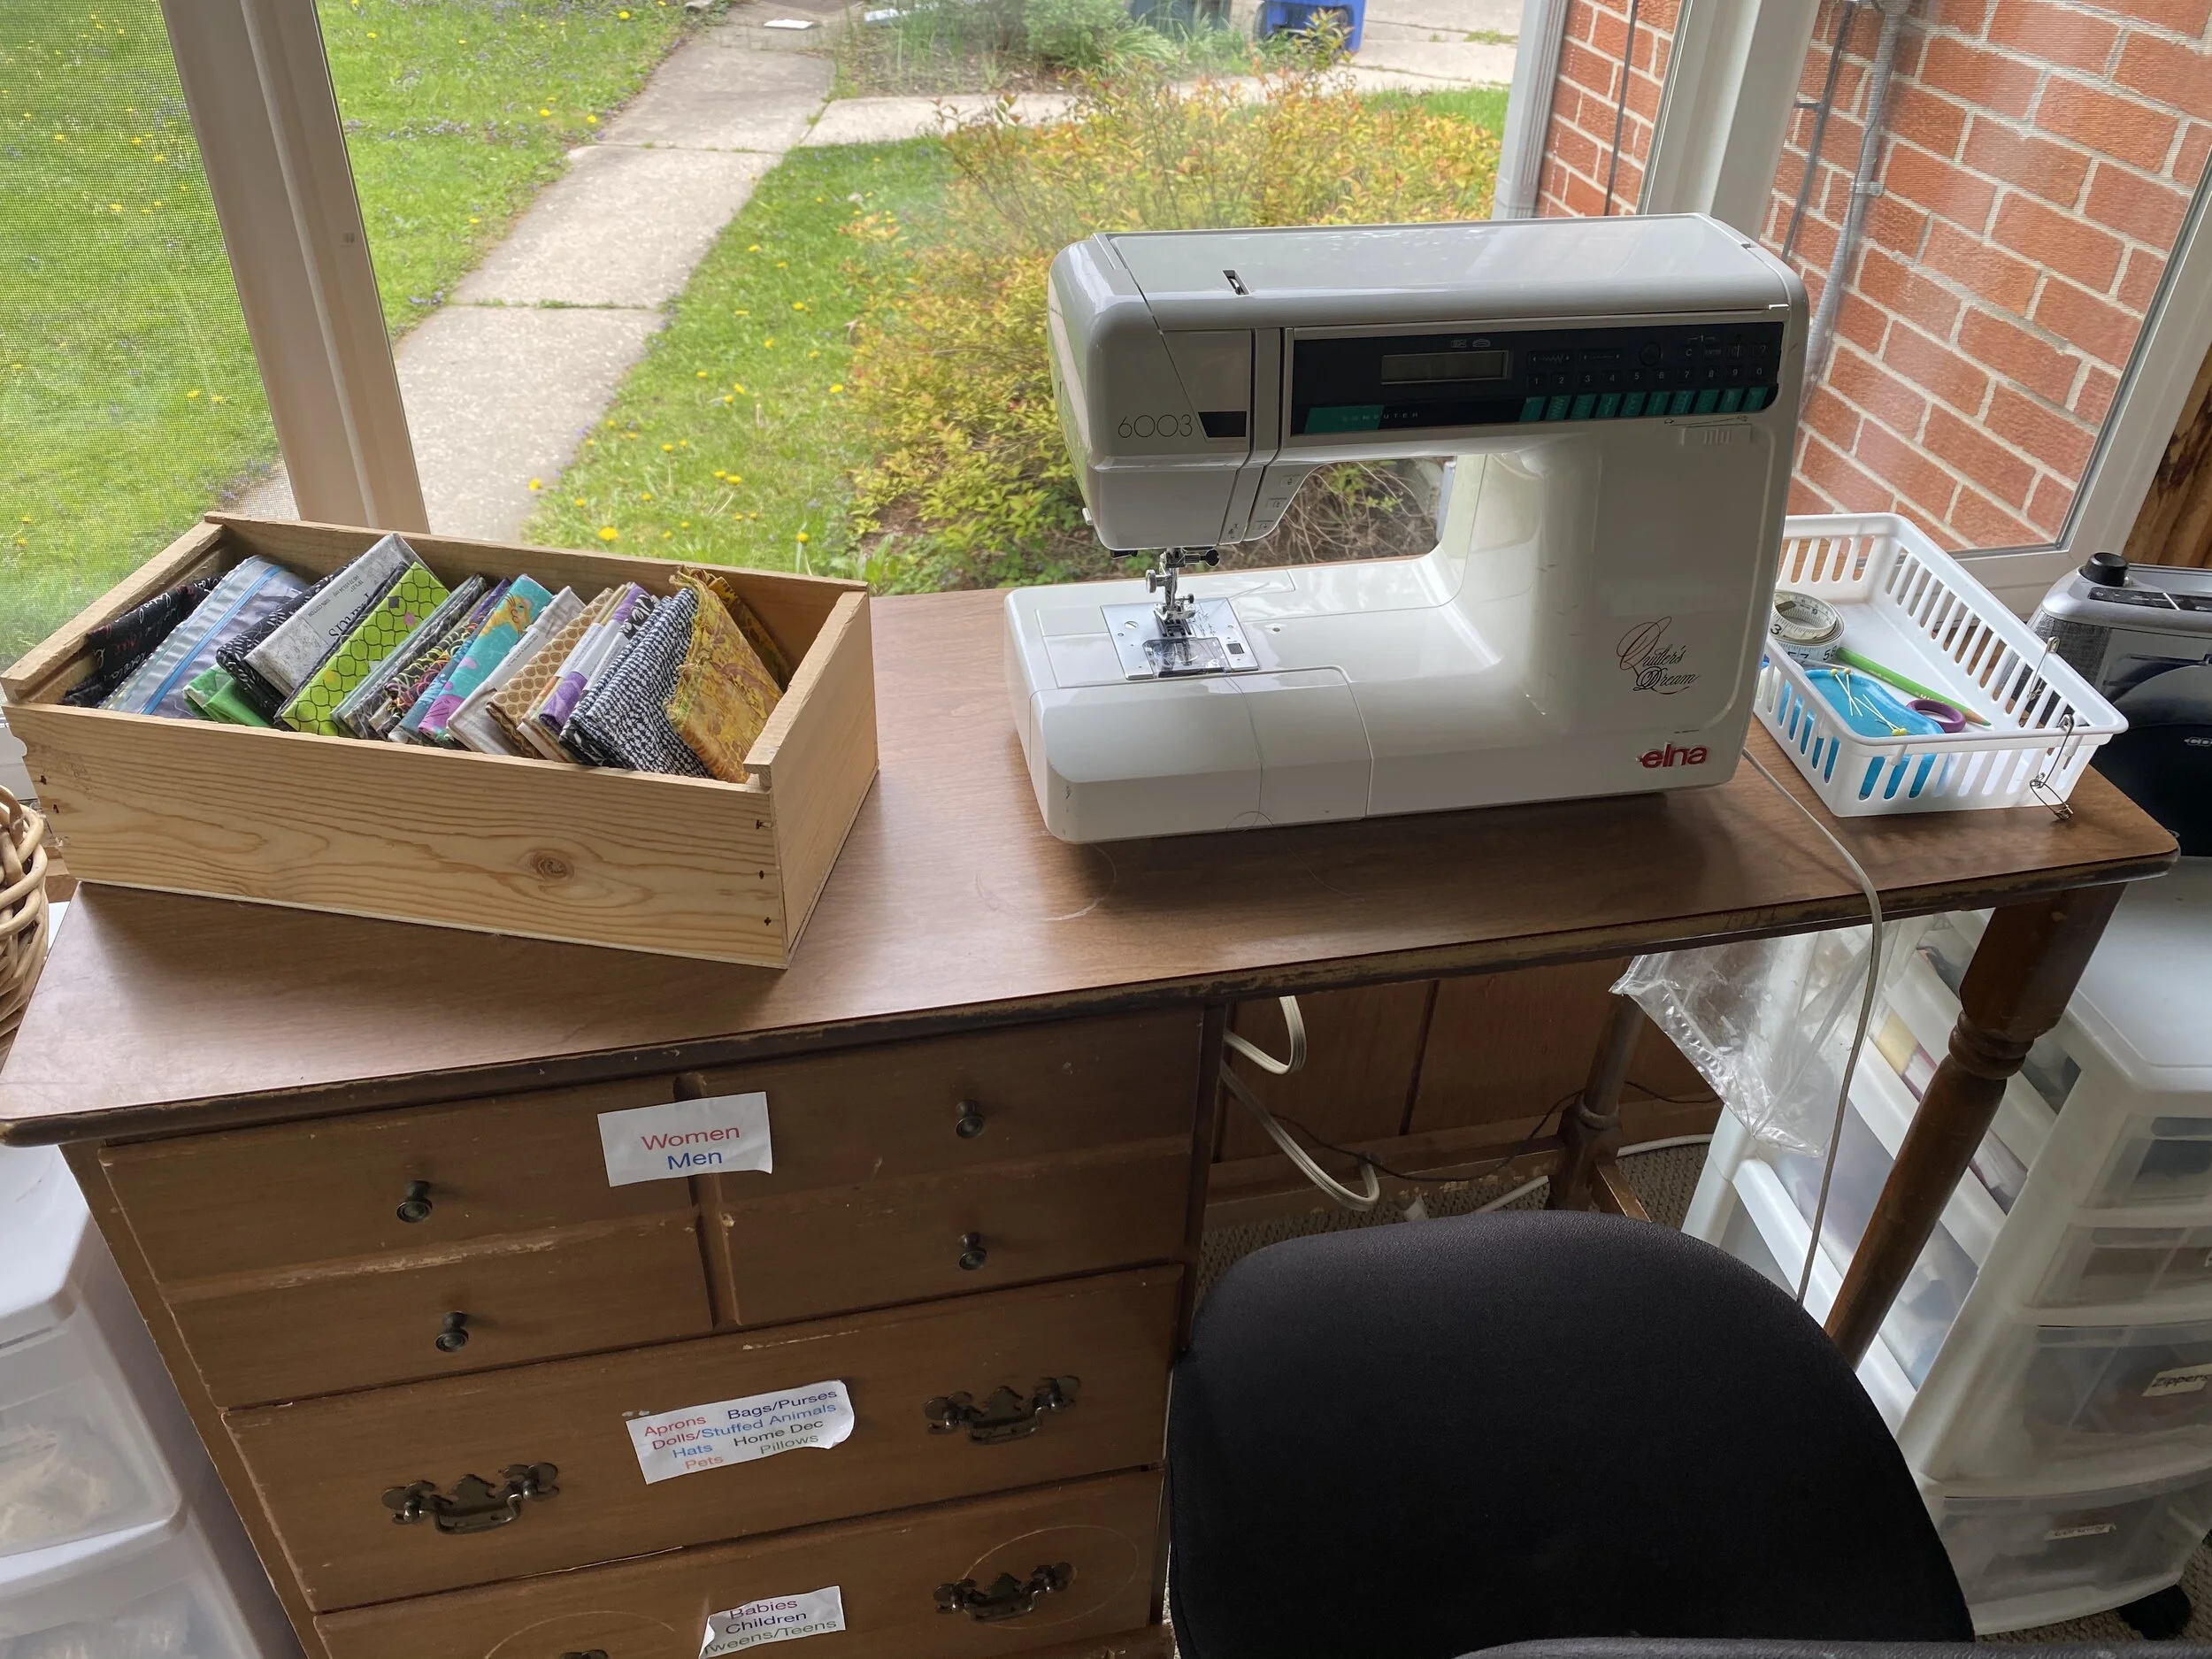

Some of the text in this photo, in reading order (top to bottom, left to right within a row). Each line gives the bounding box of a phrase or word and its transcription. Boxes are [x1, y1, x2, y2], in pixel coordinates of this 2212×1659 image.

[1118, 414, 1193, 438] 6003
[1770, 624, 1782, 635] 3
[1632, 666, 1701, 695] Dream
[1640, 741, 1709, 768] elna
[641, 1127, 740, 1150] Women
[667, 1152, 722, 1170] Men
[644, 1390, 837, 1437] Aprons Bags/Purses
[652, 1402, 837, 1450] Dolls/Stuffed Animals
[672, 1419, 824, 1458] Hats Home Dec
[685, 1434, 819, 1470] Pets Pillows
[729, 1600, 798, 1619] Babies
[726, 1612, 807, 1634] Children
